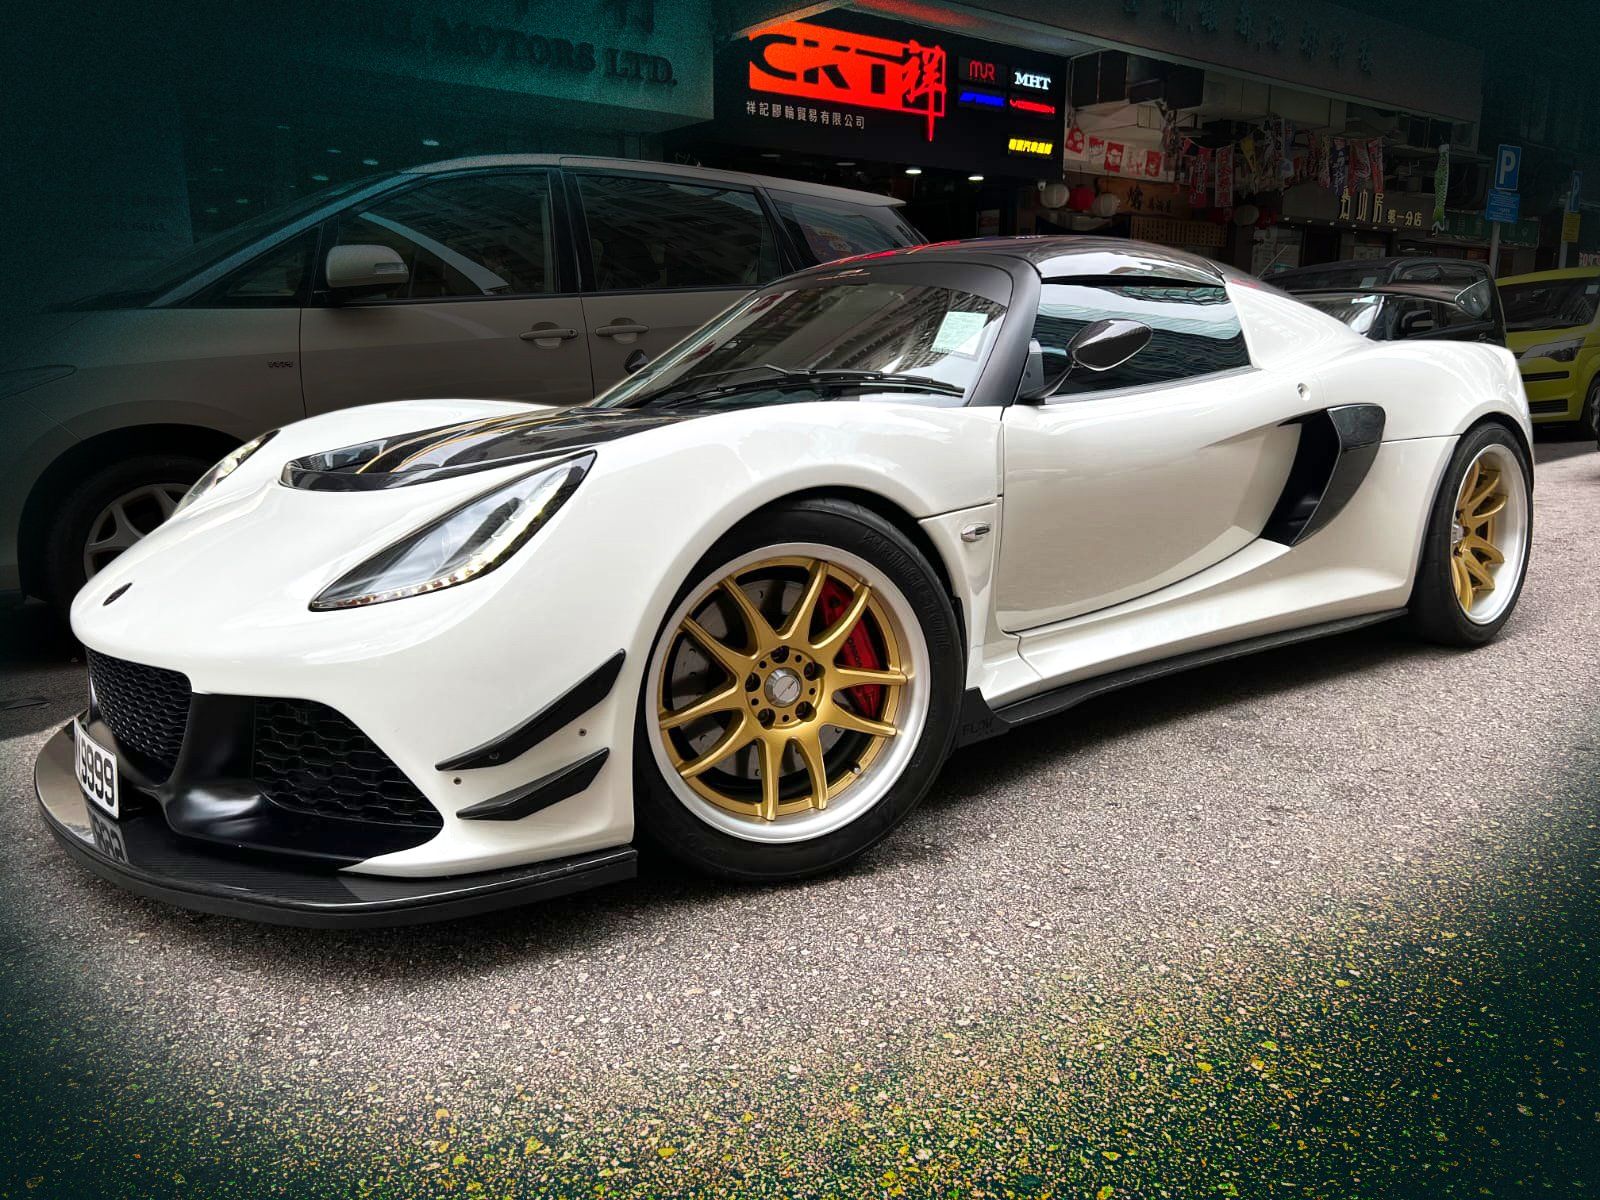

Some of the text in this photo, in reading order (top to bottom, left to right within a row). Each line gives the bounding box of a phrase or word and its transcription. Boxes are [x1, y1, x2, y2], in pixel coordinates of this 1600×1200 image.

[432, 17, 596, 73] MOTORS
[604, 47, 679, 87] LTD.
[750, 33, 902, 95] CKT
[1014, 71, 1051, 90] MHT
[1499, 150, 1516, 185] P
